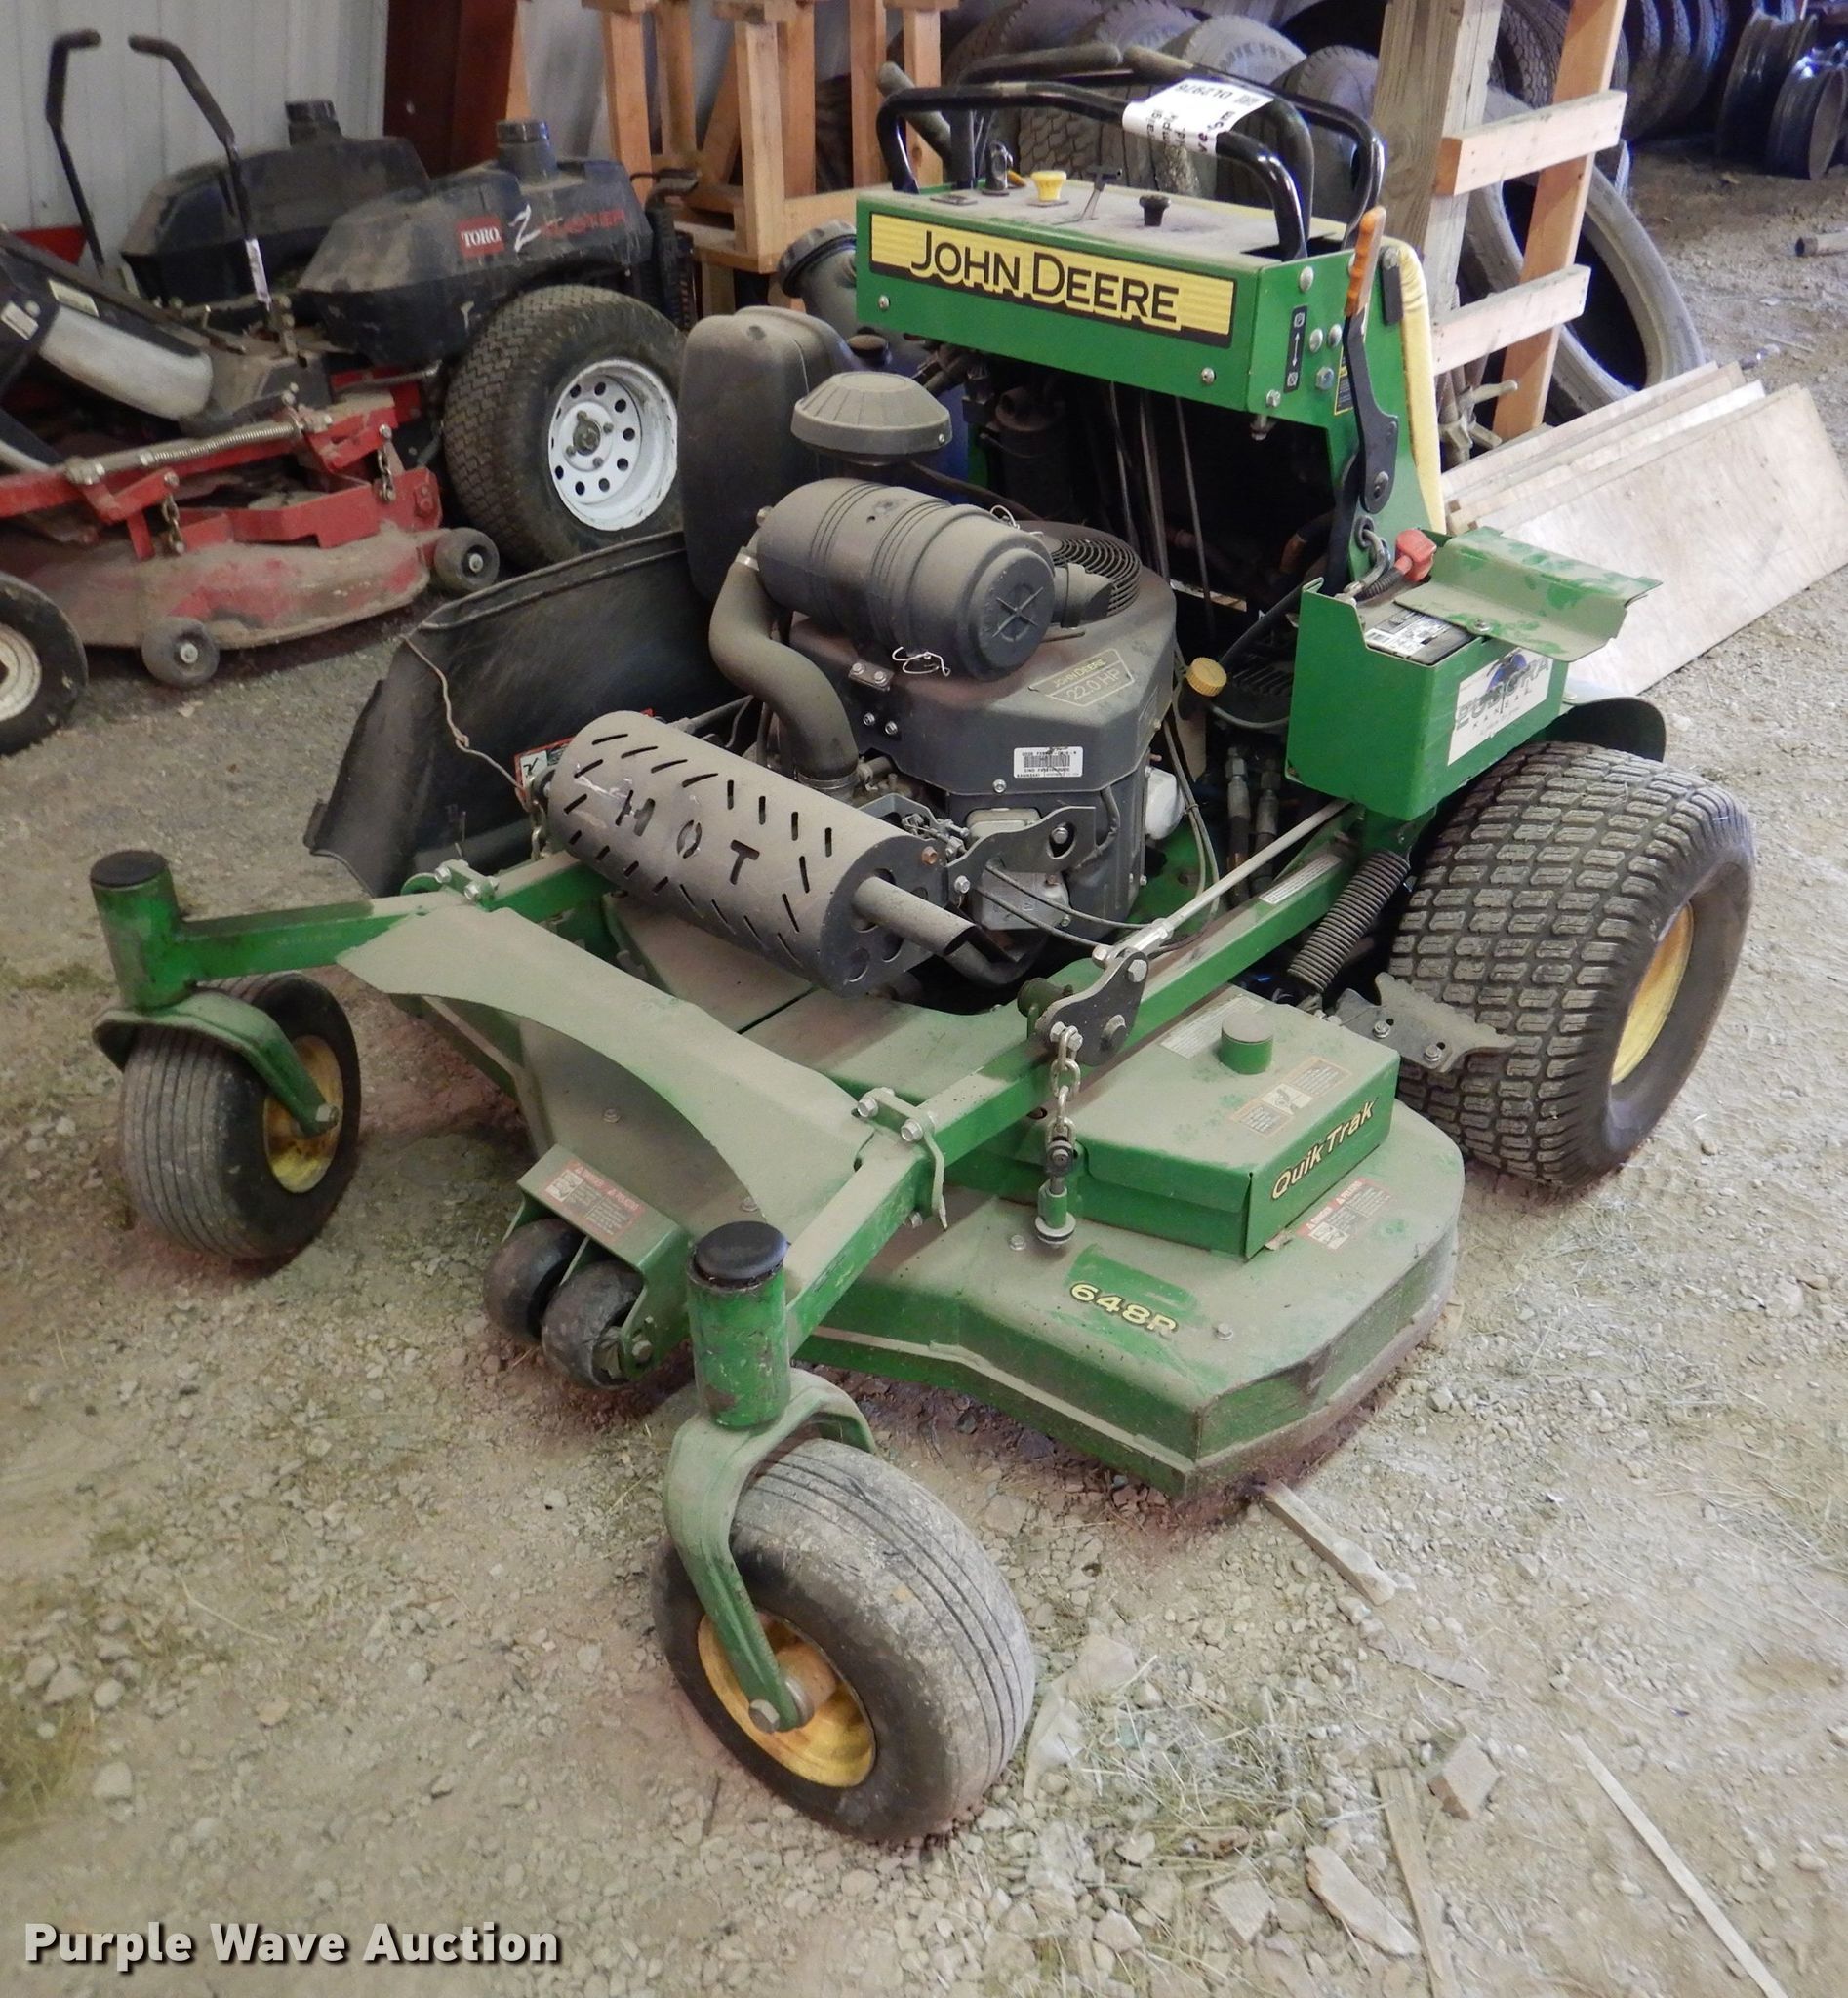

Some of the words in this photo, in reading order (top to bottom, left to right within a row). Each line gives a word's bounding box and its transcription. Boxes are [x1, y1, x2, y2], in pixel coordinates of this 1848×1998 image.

[461, 226, 502, 248] TORO
[911, 230, 1021, 292] JOHN
[1032, 251, 1181, 324] DEERE
[615, 789, 761, 885] HOT
